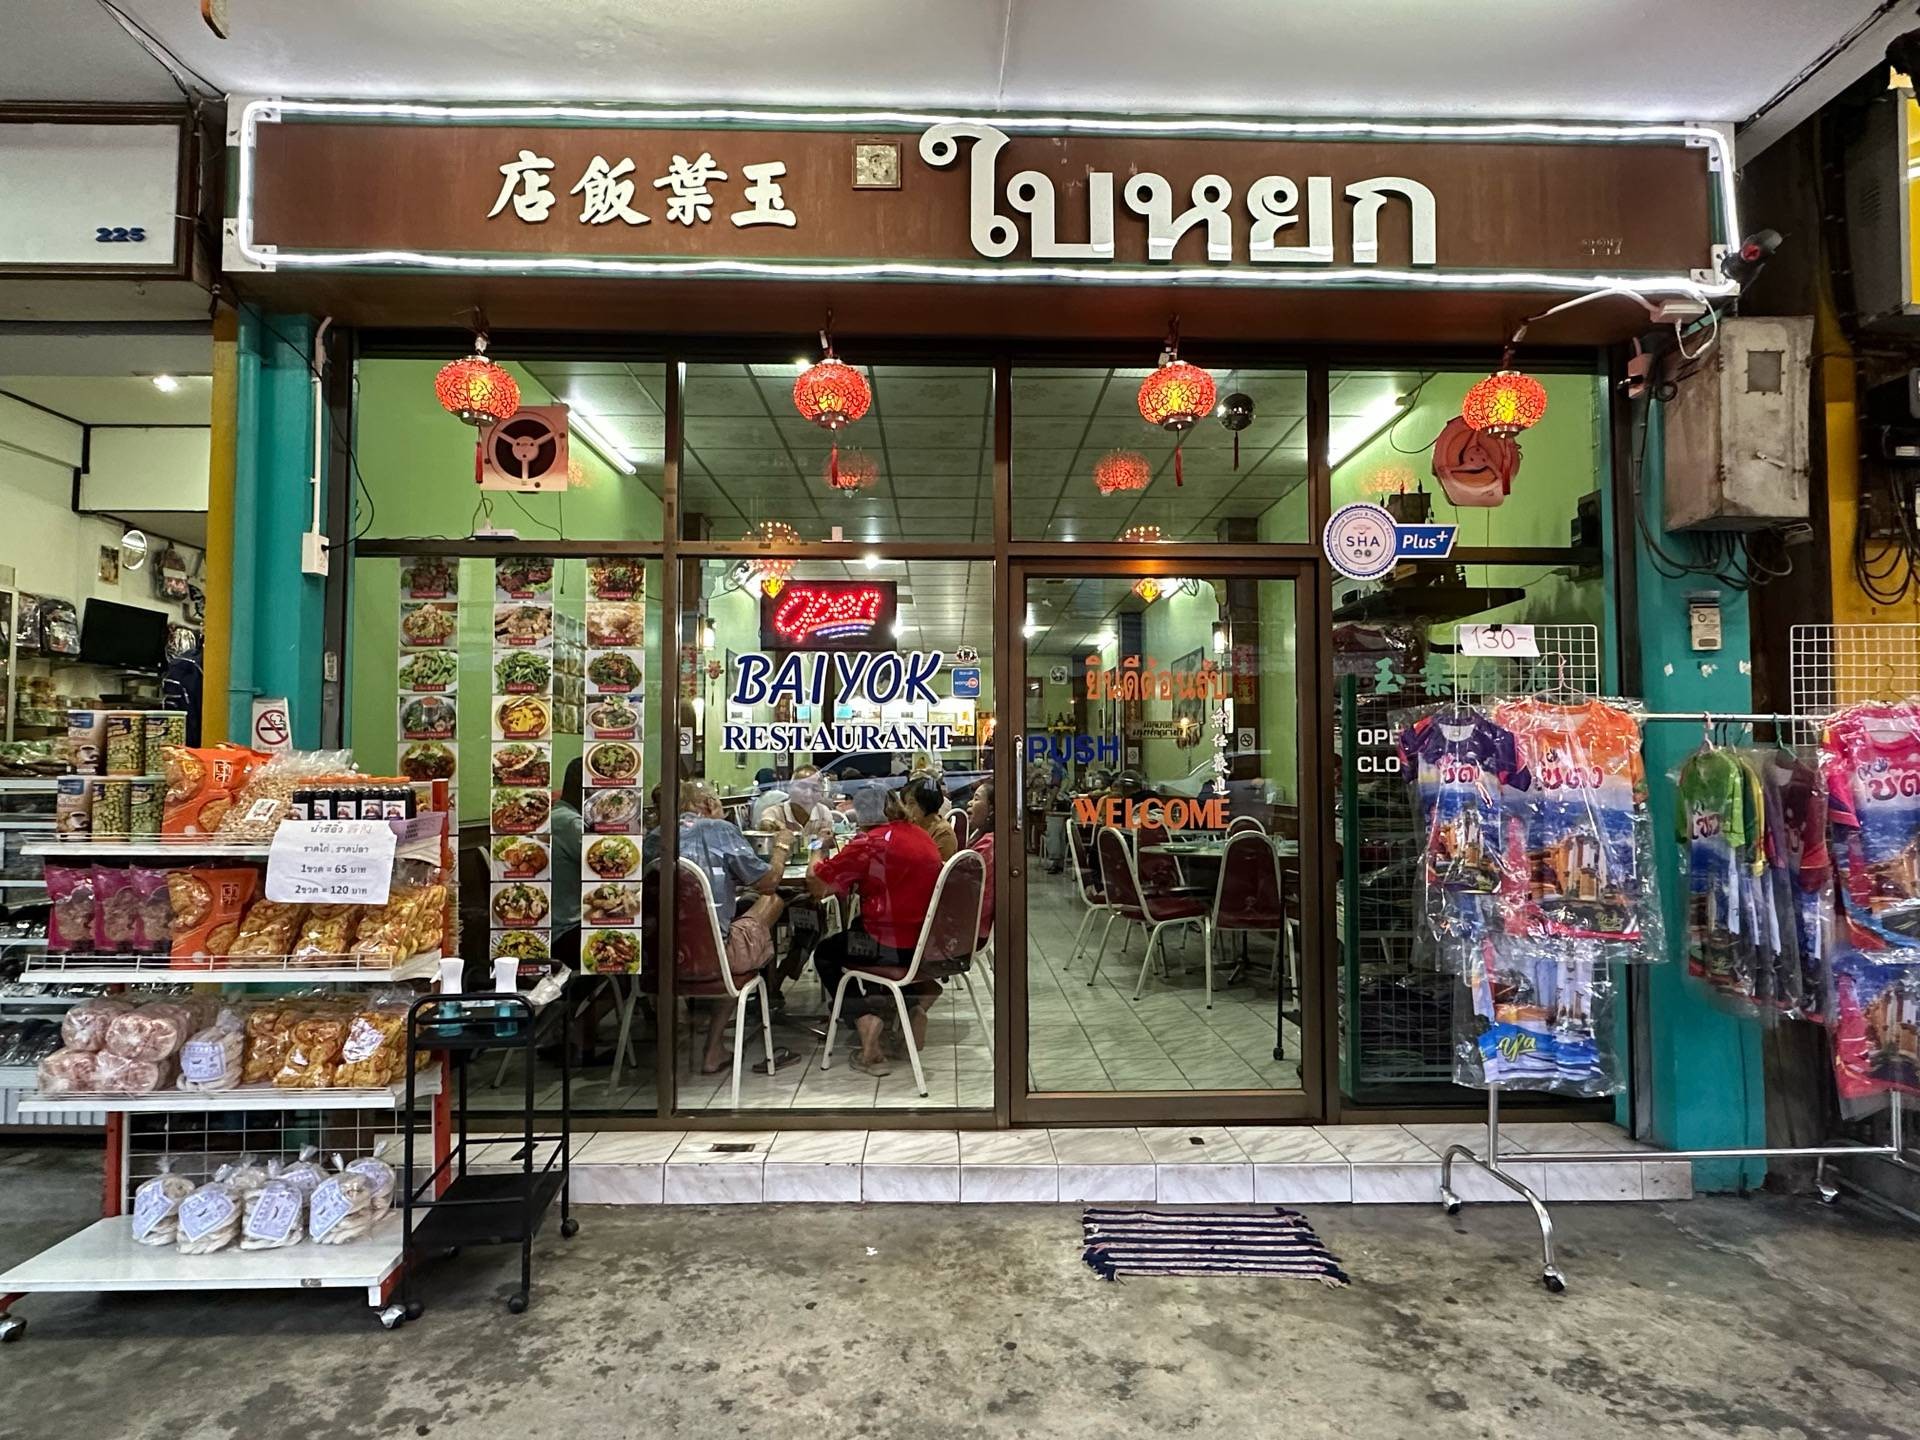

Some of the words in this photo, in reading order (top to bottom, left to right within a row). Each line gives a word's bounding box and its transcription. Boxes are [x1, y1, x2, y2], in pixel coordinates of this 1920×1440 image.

[919, 123, 1437, 264] ใบหยก
[95, 227, 145, 242] 225
[1346, 535, 1380, 548] SHA
[776, 590, 881, 641] Open
[733, 653, 941, 704] BAIYOK
[723, 725, 953, 750] RESTAURANT
[1357, 729, 1403, 746] OPE
[1028, 736, 1119, 763] PUSH
[1357, 756, 1401, 773] CLO
[1073, 798, 1230, 829] WELCOME
[334, 864, 347, 873] 65
[330, 885, 349, 894] 120
